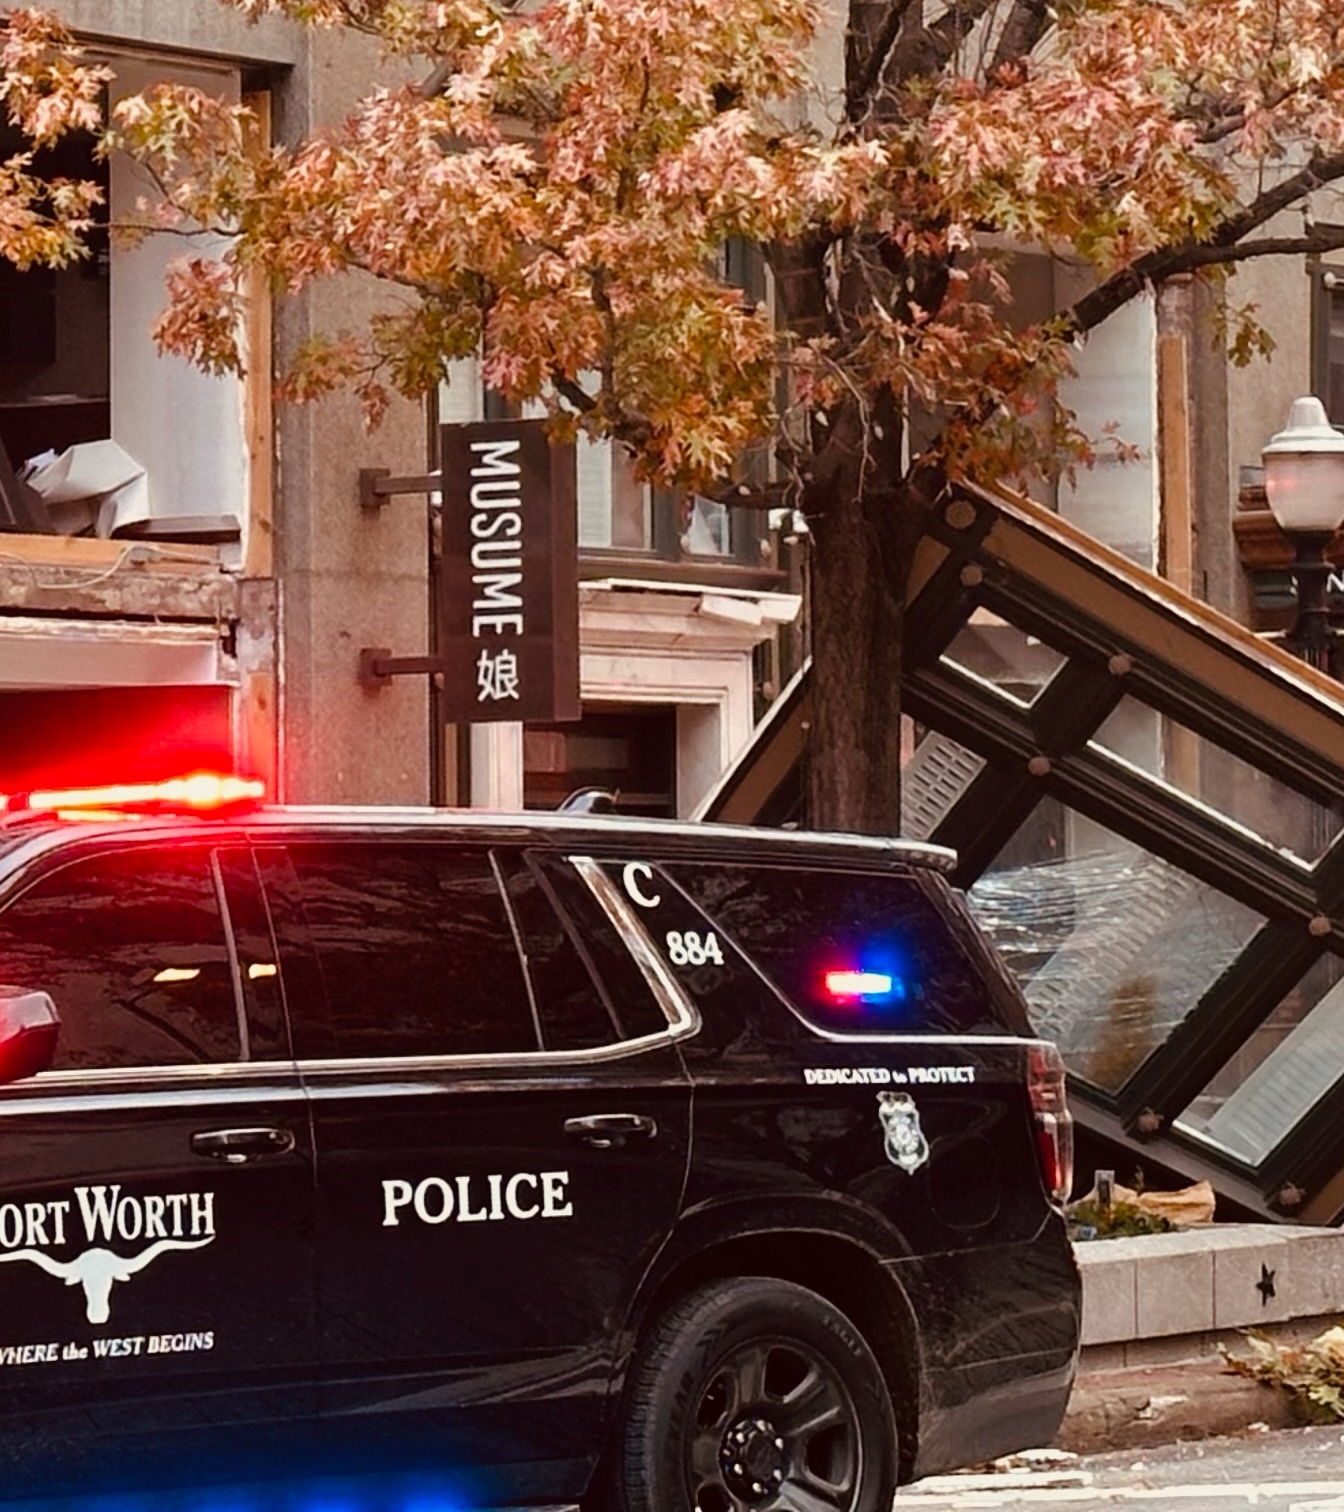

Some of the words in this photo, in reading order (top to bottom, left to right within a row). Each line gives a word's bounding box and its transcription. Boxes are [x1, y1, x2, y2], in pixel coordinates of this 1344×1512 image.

[469, 440, 524, 638] MUSUME
[476, 648, 520, 702] 娘
[622, 861, 661, 908] C
[666, 930, 725, 967] 884
[803, 1068, 891, 1085] DEDICATED
[907, 1066, 976, 1084] PROTECT
[73, 1184, 216, 1243] WORTH
[382, 1170, 574, 1227] POLICE
[62, 1342, 89, 1361] the
[92, 1336, 145, 1358] WEST
[147, 1331, 215, 1354] BEGINS
